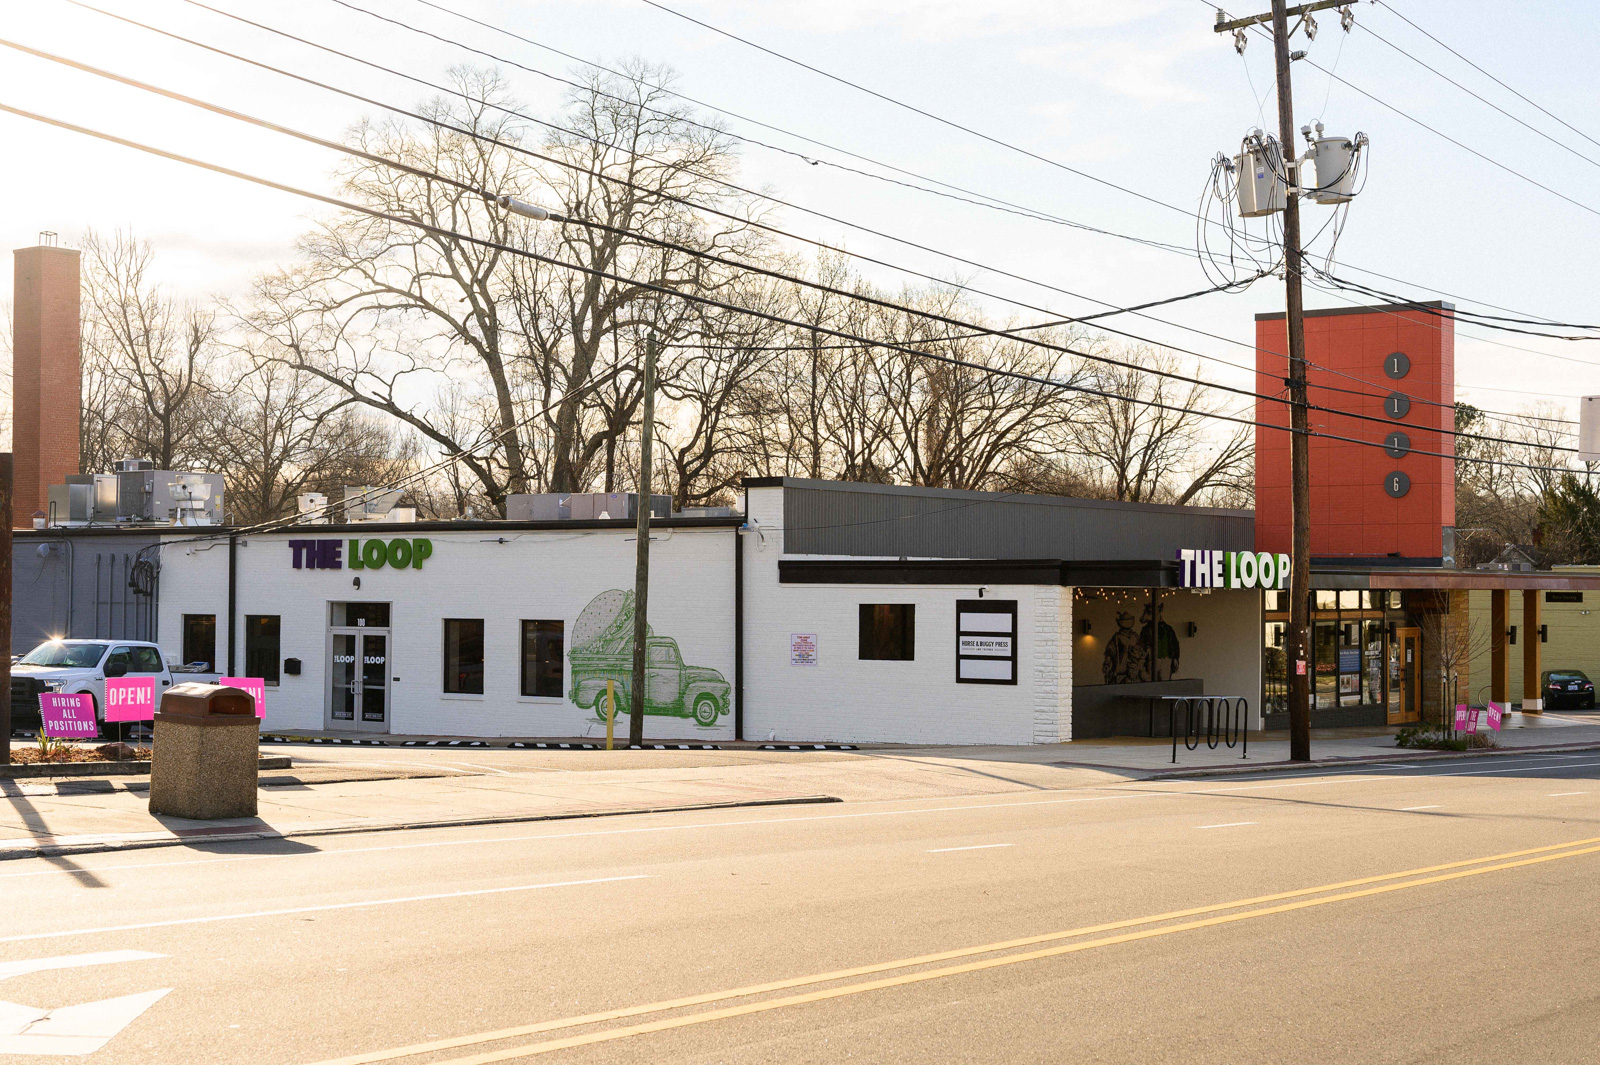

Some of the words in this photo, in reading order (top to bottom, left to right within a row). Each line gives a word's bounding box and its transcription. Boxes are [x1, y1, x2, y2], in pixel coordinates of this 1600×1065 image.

[289, 540, 343, 570] THE
[348, 538, 433, 570] LOOP
[1176, 549, 1225, 588] THE
[1225, 551, 1291, 589] LOOP
[336, 655, 355, 664] LOOP
[366, 656, 386, 664] LOOP
[109, 686, 152, 706] OPEN!
[52, 697, 81, 708] HIRING
[62, 709, 77, 719] ALL
[1488, 706, 1501, 723] OPEN!
[48, 720, 95, 731] POSITIONS
